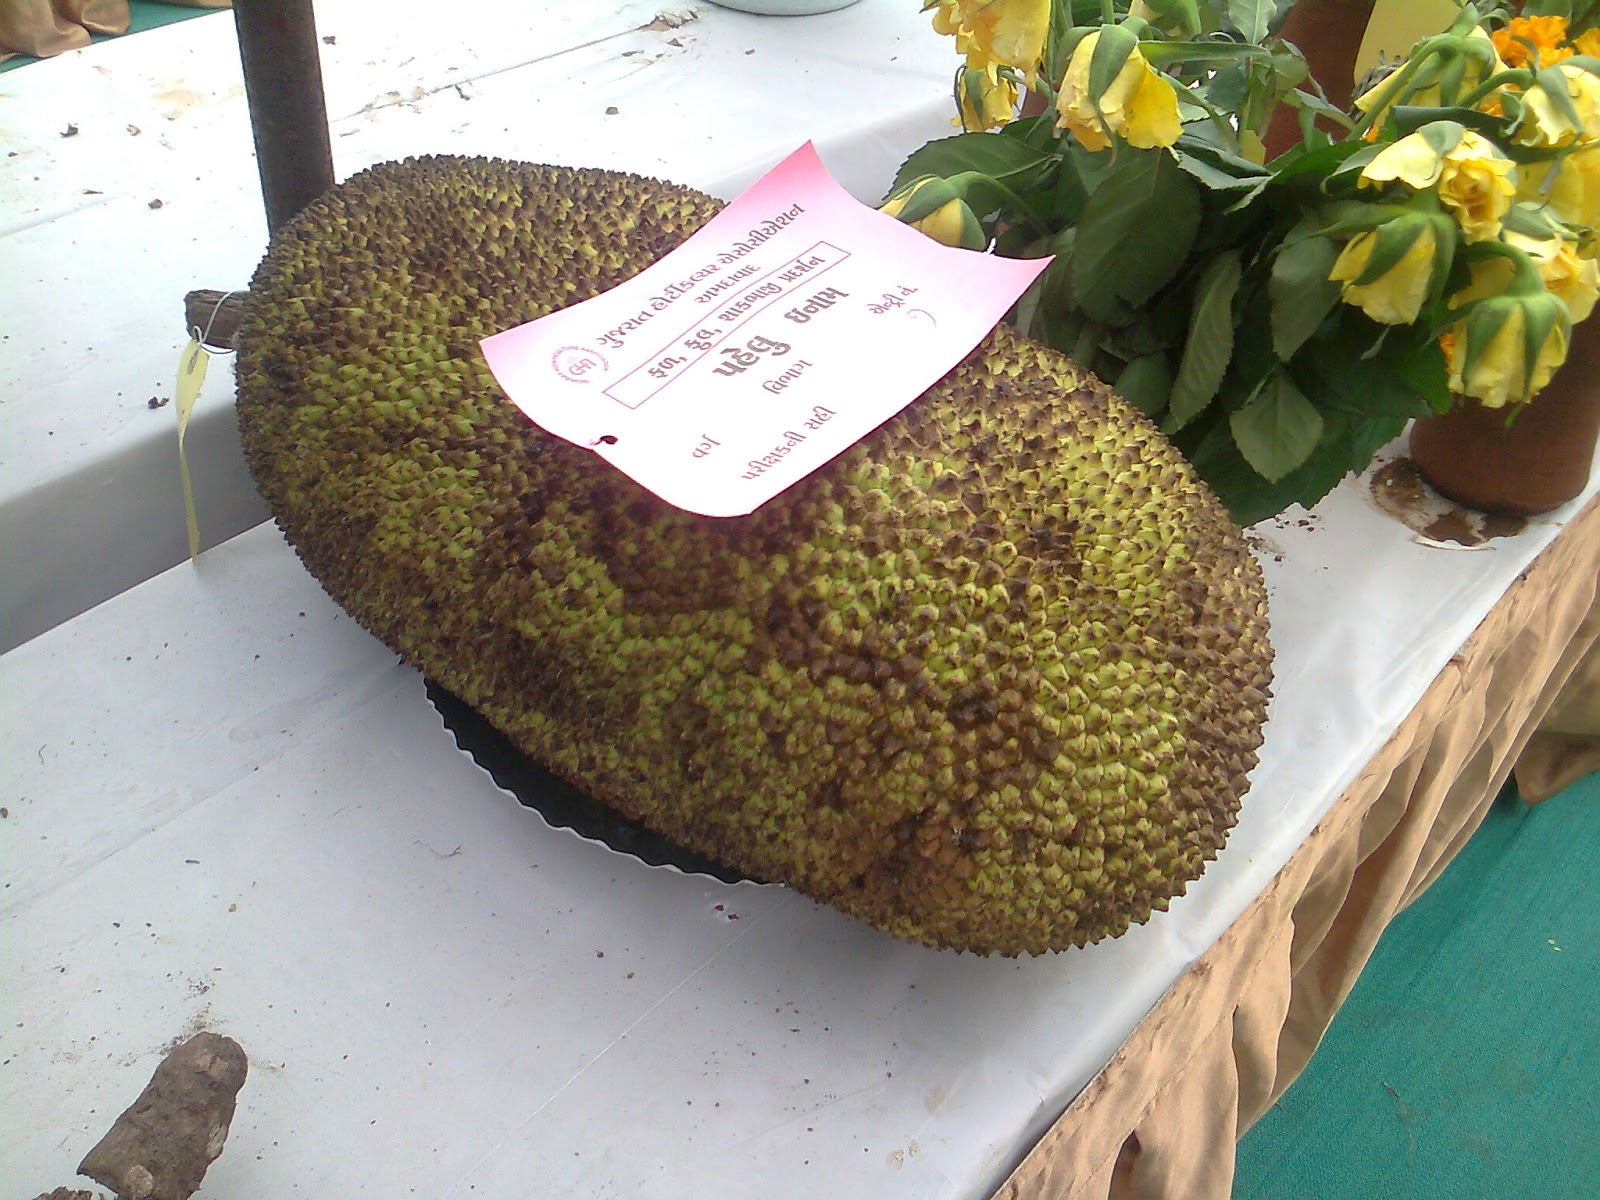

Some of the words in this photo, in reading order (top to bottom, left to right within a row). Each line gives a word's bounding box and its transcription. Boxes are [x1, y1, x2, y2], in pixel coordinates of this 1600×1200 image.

[595, 310, 655, 349] ગુજરાત
[716, 202, 805, 264] એસોસીએશન
[694, 264, 761, 304] અમદાવાદ
[717, 282, 783, 322] શાકભાજી
[762, 359, 813, 395] વિભાગ
[803, 405, 837, 430] સહી
[691, 433, 722, 459] વર્ગ
